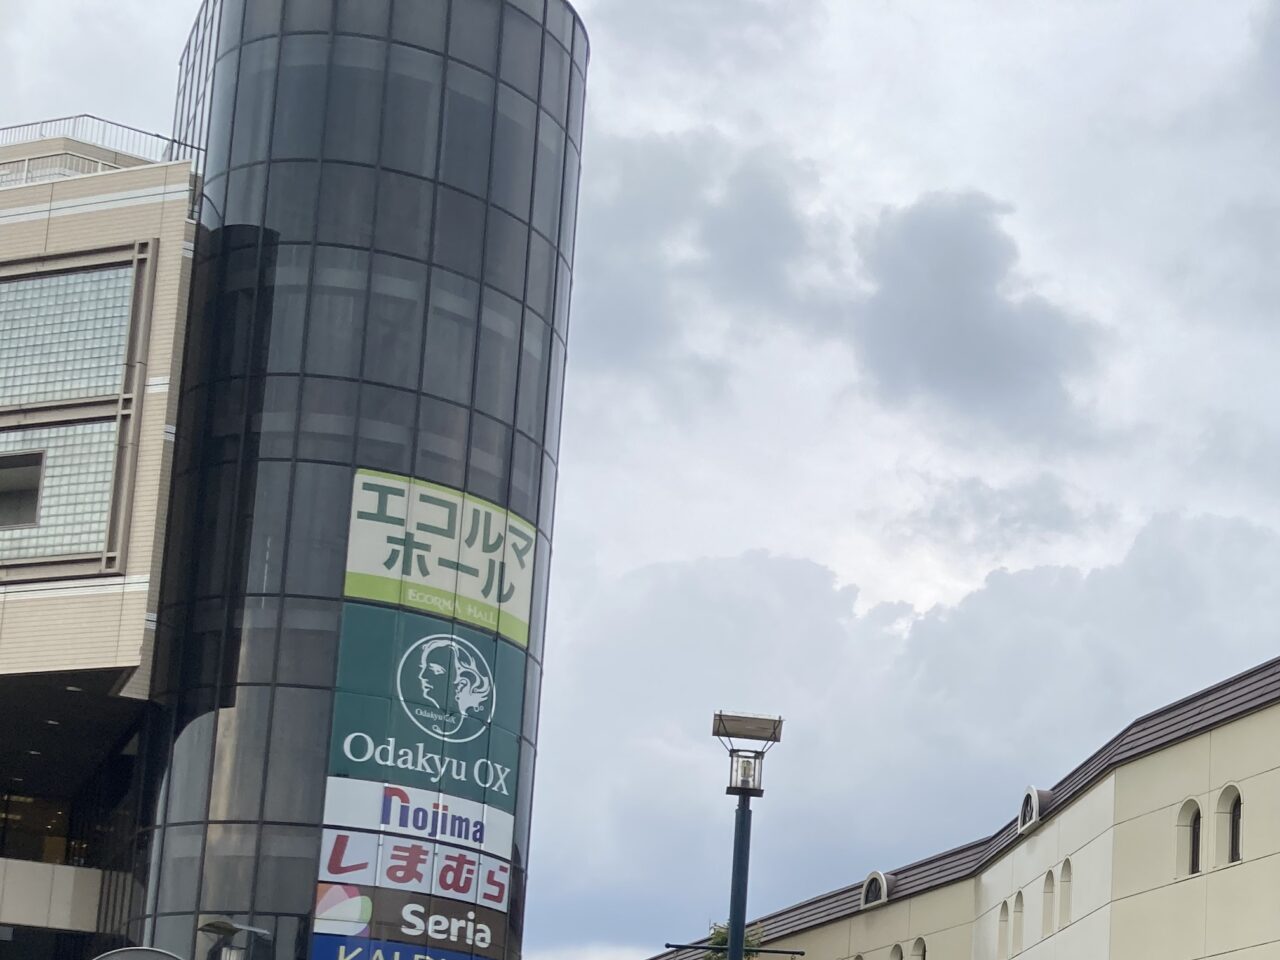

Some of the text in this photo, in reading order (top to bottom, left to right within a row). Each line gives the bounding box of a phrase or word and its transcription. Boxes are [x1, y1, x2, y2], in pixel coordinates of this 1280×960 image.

[357, 482, 534, 569] エコルマ
[383, 531, 515, 603] ホール
[343, 732, 511, 796] Odakyu OX
[327, 835, 508, 903] しまむら
[400, 903, 492, 948] Seria
